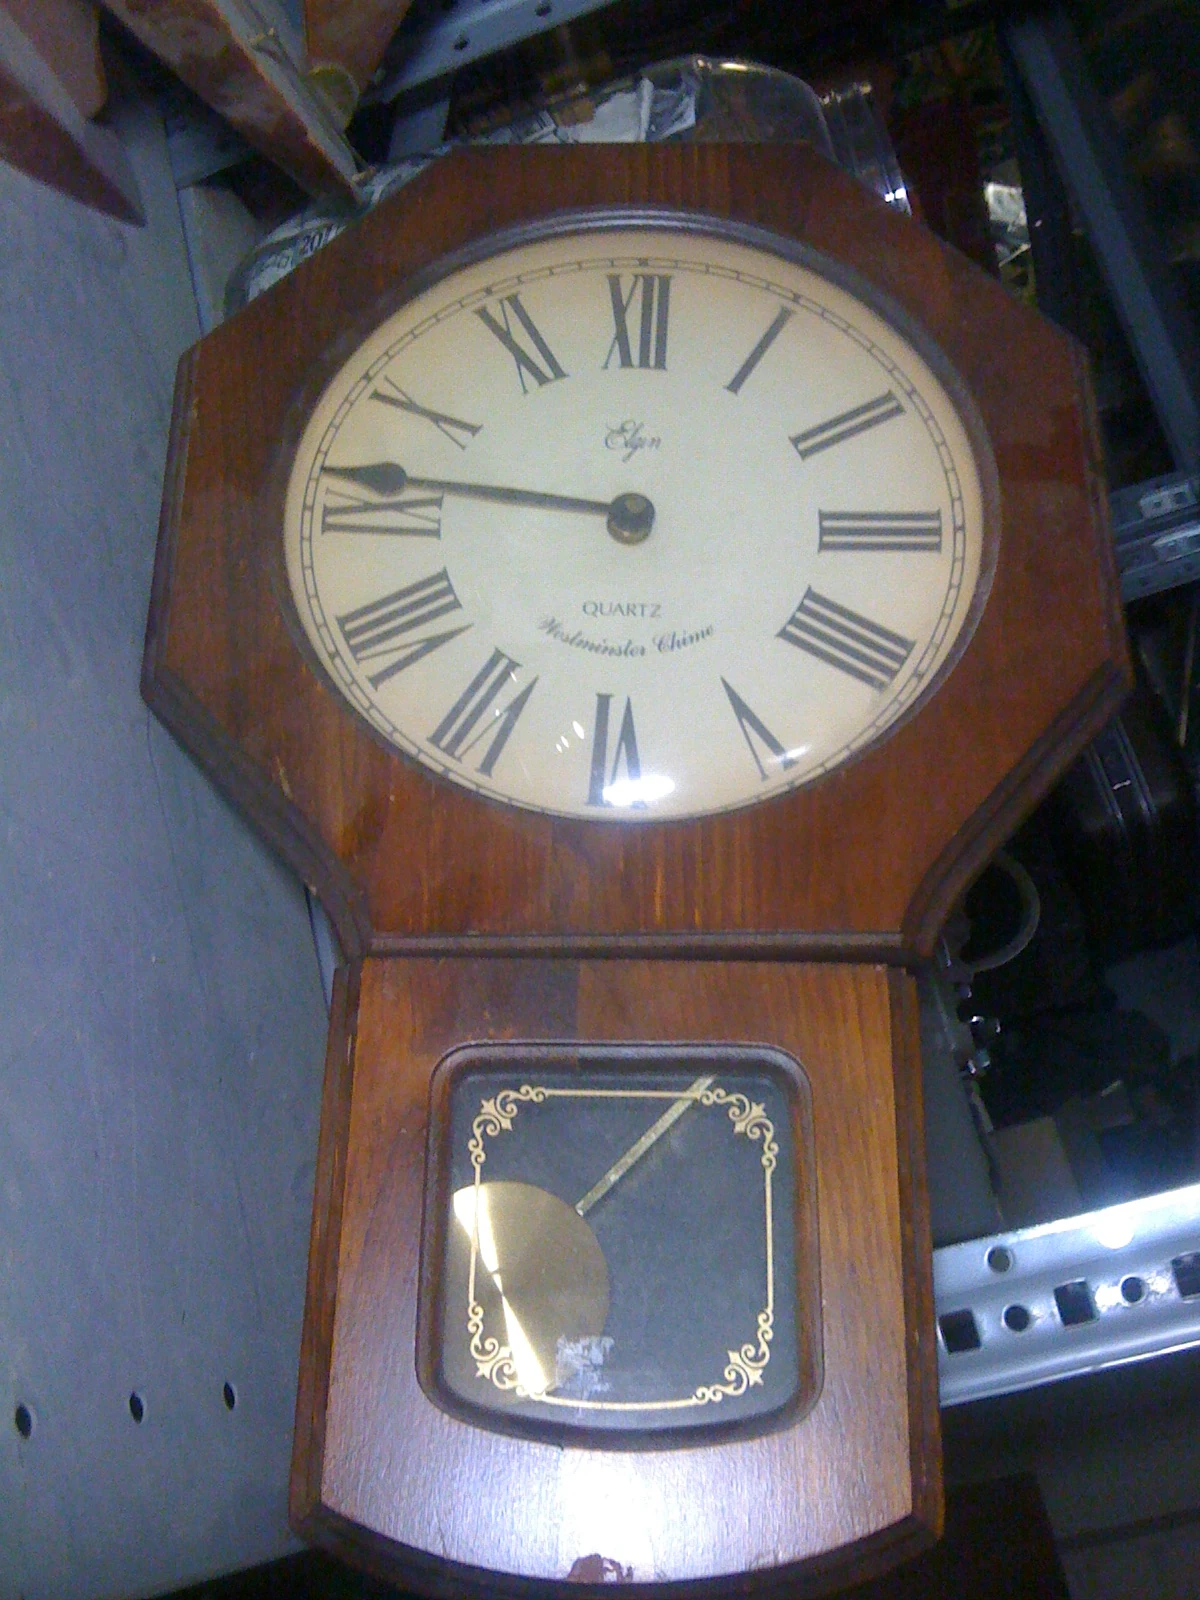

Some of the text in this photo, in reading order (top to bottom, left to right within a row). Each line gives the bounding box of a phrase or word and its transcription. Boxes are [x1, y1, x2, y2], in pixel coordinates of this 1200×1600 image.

[472, 293, 568, 394] XI
[601, 274, 672, 370] XII
[723, 305, 796, 395] I
[369, 375, 483, 451] X
[789, 389, 906, 461] II
[321, 486, 444, 540] IX
[817, 508, 942, 553] III
[335, 566, 475, 692] VIII
[538, 616, 714, 657] Westminster Chime
[581, 601, 662, 618] QUARTZ
[775, 584, 917, 694] IIII
[426, 647, 540, 778] VII
[585, 692, 650, 810] VI
[719, 675, 800, 782] V
